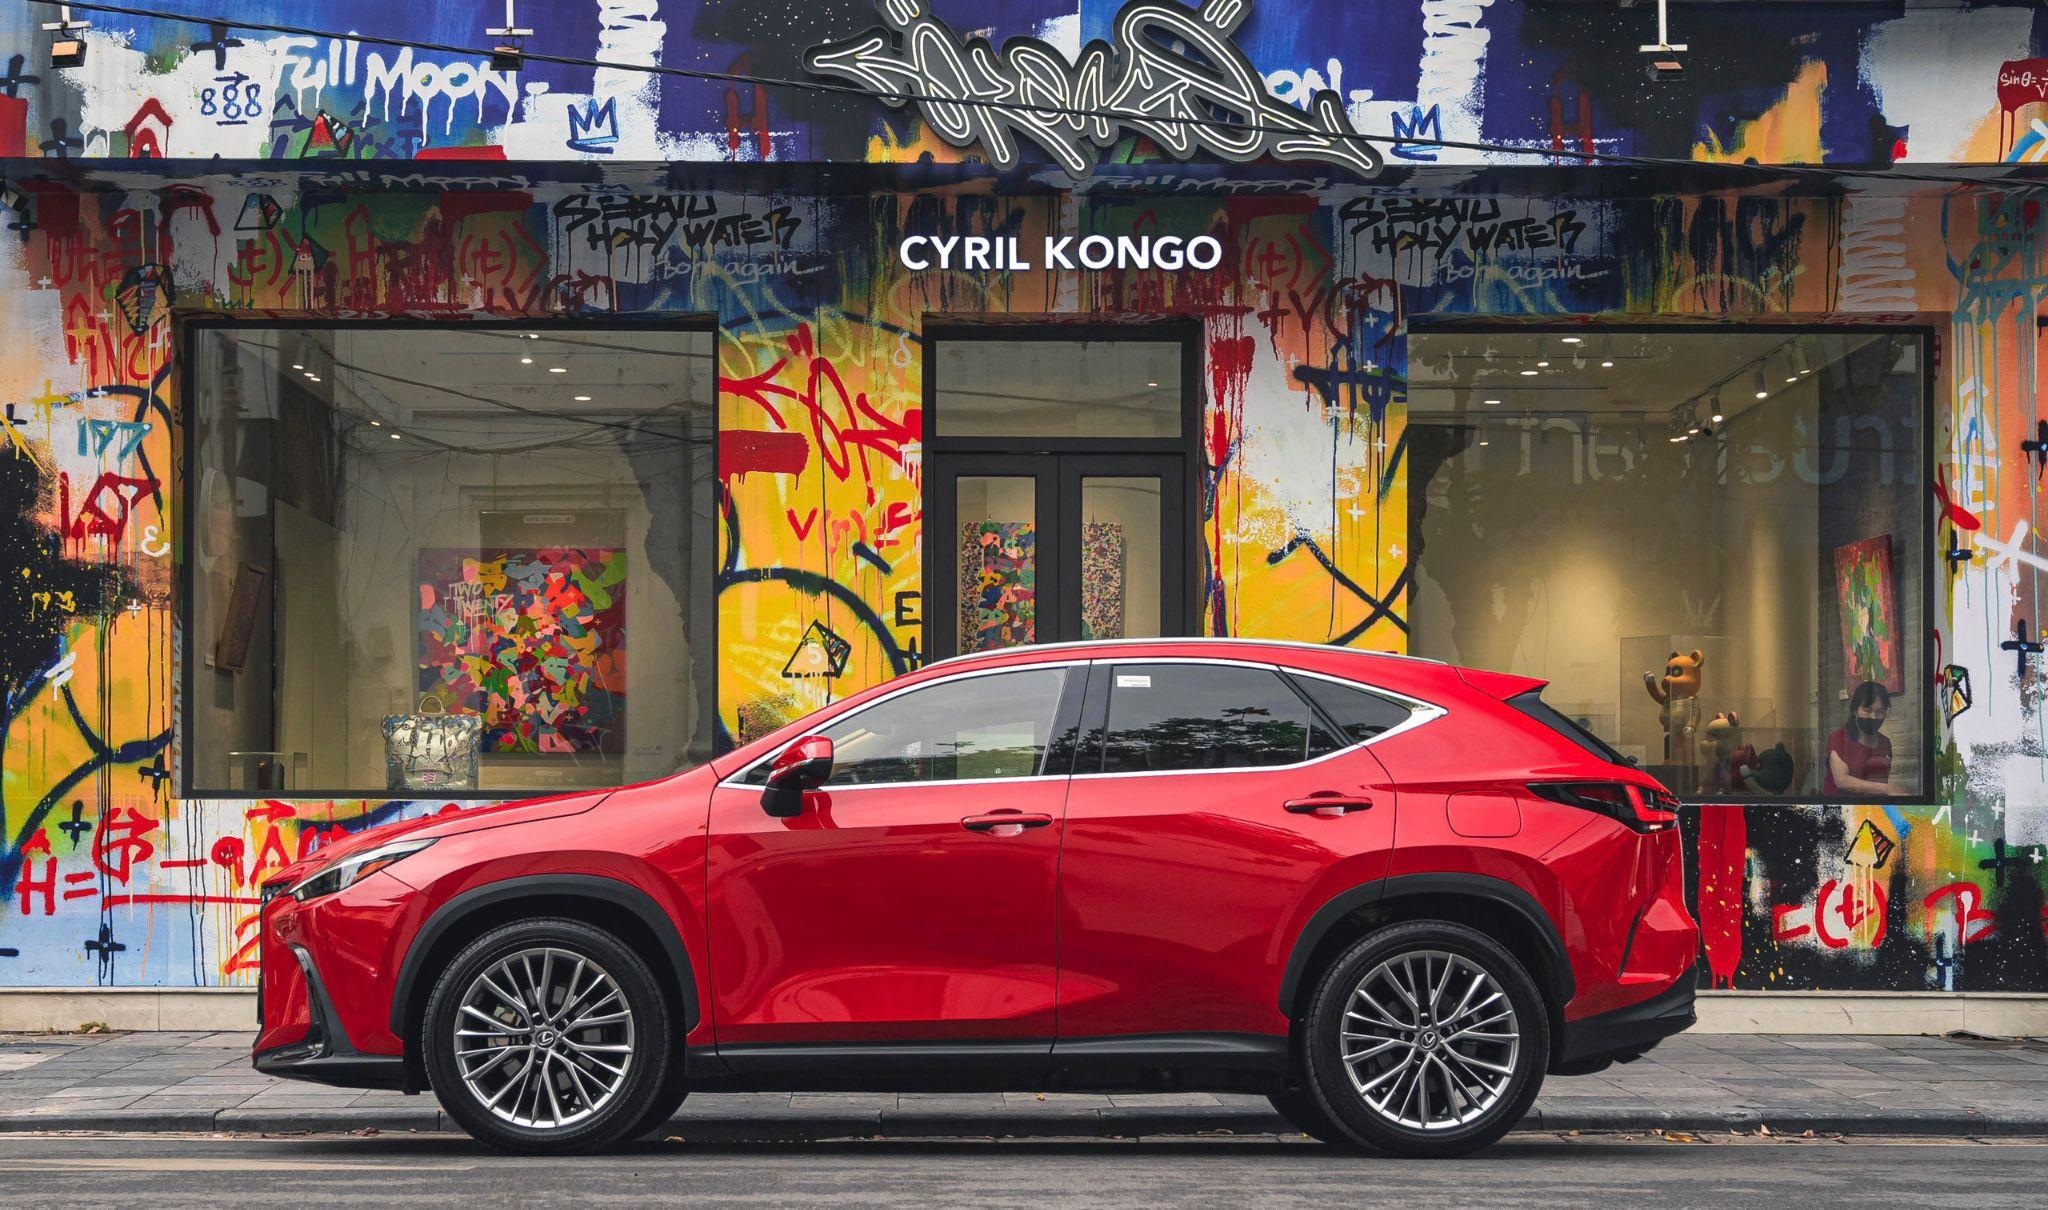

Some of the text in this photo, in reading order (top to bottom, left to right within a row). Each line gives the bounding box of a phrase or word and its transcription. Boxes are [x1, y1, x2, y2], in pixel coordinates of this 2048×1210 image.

[587, 206, 802, 256] HOLY WATER
[900, 234, 1222, 271] CYRIL KONGO
[1372, 210, 1587, 260] HOLY WATER
